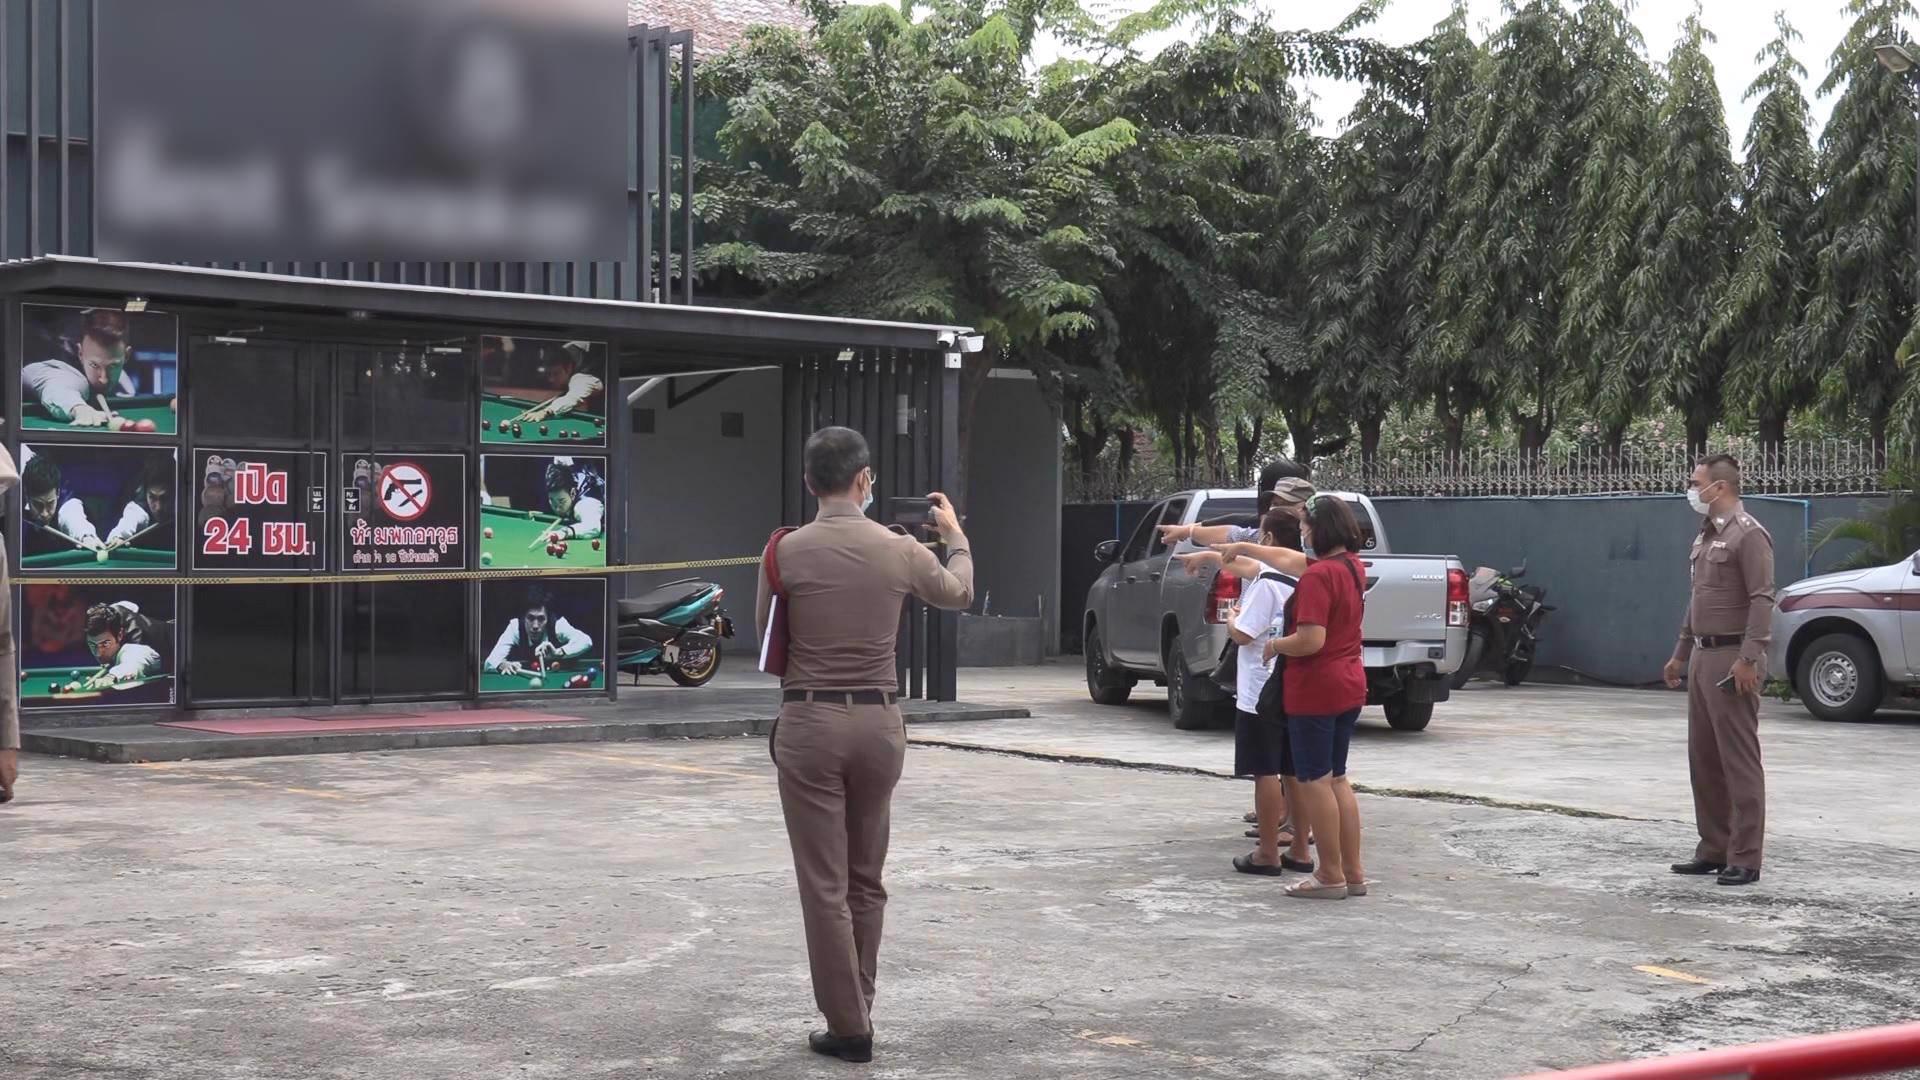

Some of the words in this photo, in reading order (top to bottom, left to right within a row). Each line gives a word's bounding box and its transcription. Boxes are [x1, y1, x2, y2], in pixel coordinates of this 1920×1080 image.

[235, 463, 288, 504] เปิด
[203, 516, 252, 555] 24
[350, 518, 458, 554] ห้ามพกอาวุธ
